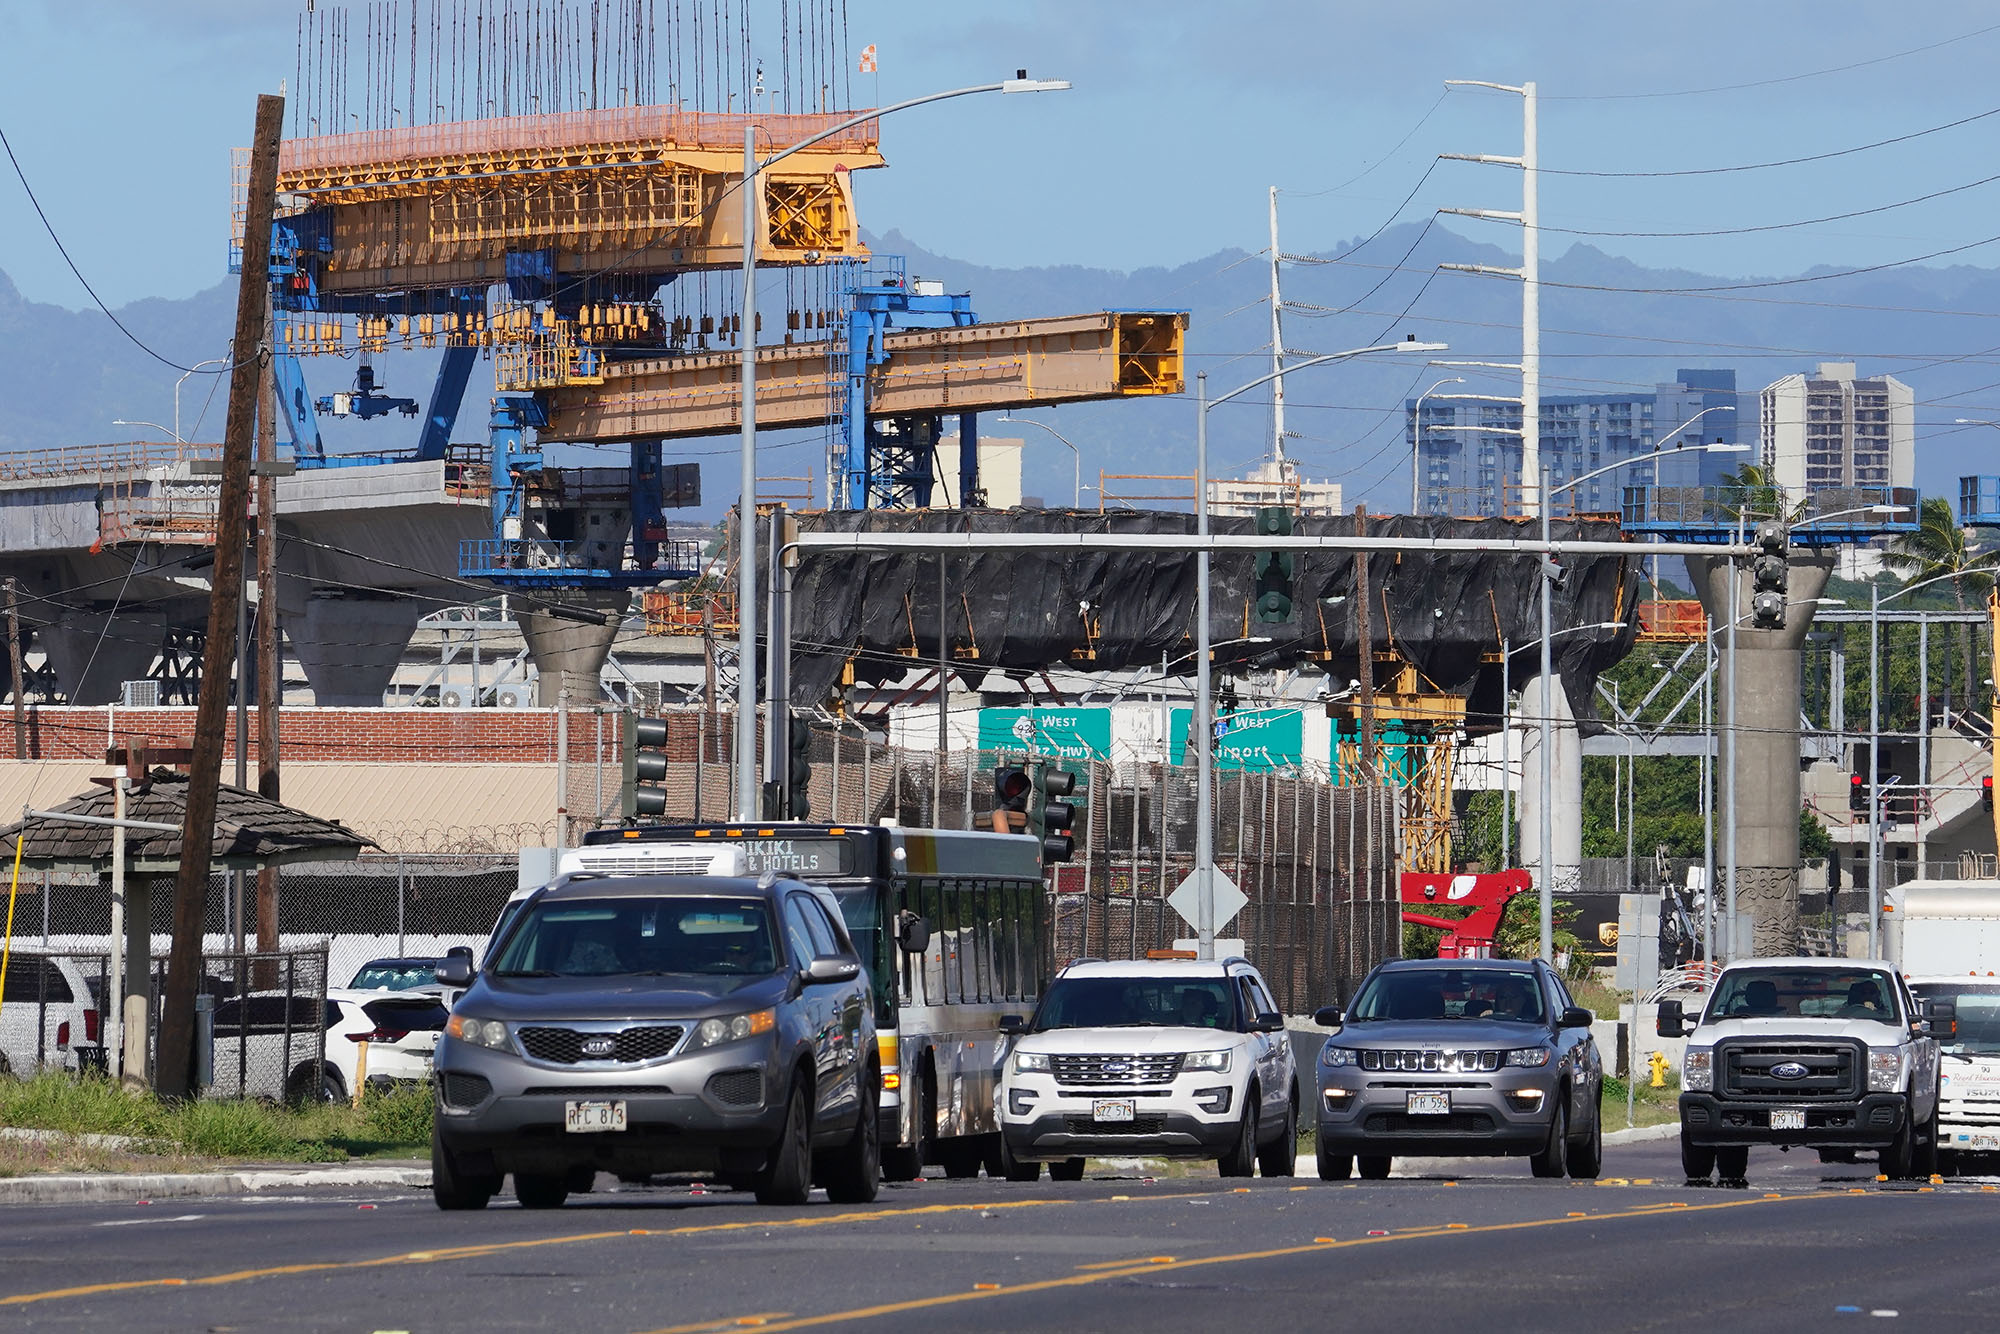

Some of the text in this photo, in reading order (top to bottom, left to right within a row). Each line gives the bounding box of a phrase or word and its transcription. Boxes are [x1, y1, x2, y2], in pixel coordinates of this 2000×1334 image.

[1041, 715, 1077, 728] WEST
[1217, 744, 1268, 761] irport
[763, 855, 819, 871] HOTELS
[588, 1042, 608, 1052] KIA
[1778, 1064, 1799, 1076] Ford
[568, 1108, 592, 1125] RFC
